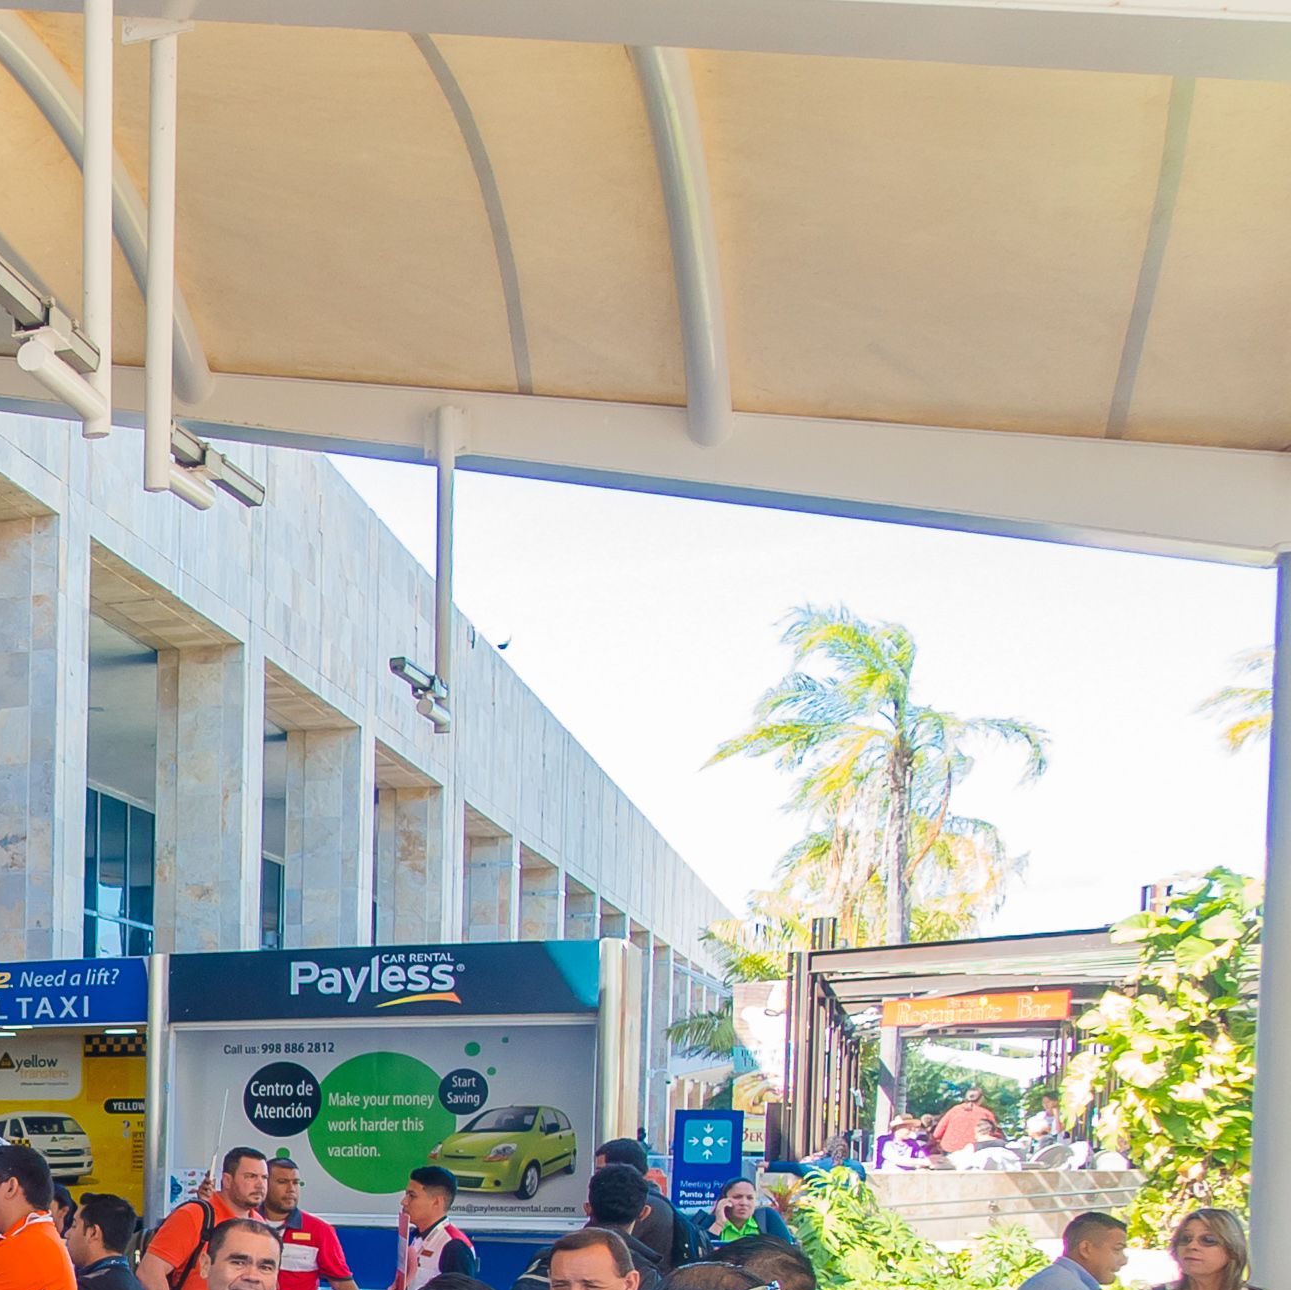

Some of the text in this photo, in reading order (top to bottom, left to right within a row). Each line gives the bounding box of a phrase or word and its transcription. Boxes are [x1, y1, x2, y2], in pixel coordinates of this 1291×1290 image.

[381, 952, 455, 963] CAR RENTAL
[19, 970, 67, 988] Need
[69, 973, 81, 986] a
[85, 968, 120, 986] lift?
[290, 955, 456, 1003] Payless
[16, 995, 90, 1019] TAXI
[1017, 995, 1052, 1019] Bar
[223, 1042, 335, 1055] Call us: 998 886 2812
[15, 1054, 58, 1072] yellow
[250, 1079, 314, 1097] Centro de
[451, 1075, 477, 1088] Start
[328, 1092, 435, 1109] Make your money
[446, 1092, 481, 1107] Saving
[254, 1102, 313, 1119] Atención
[327, 1117, 424, 1132] work harder this
[327, 1143, 381, 1157] vacation.
[680, 1180, 712, 1189] Meeting
[679, 1190, 715, 1199] Punto de
